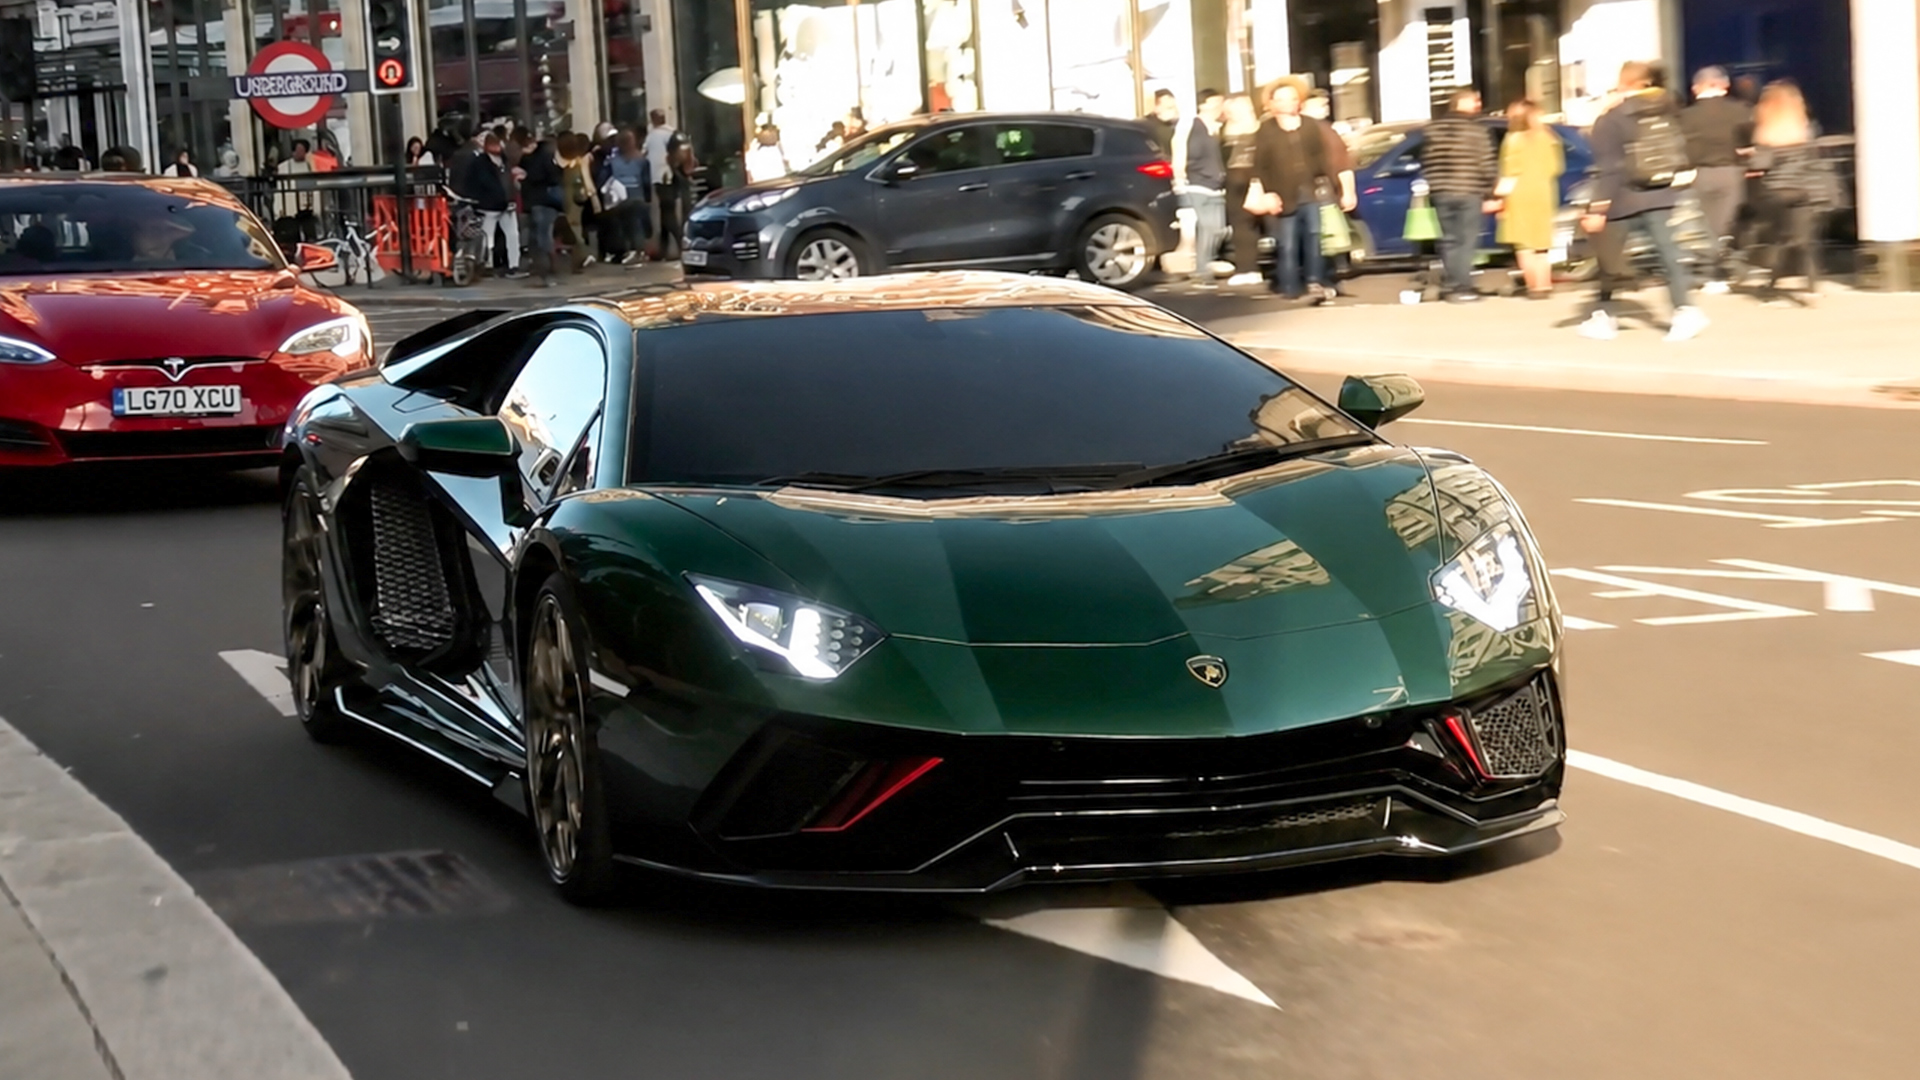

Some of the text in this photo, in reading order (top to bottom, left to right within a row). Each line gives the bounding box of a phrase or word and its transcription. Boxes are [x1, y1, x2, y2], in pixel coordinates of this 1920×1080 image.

[235, 73, 348, 97] UNDERGROUND
[127, 389, 187, 411] LG70
[193, 388, 235, 409] XCU
